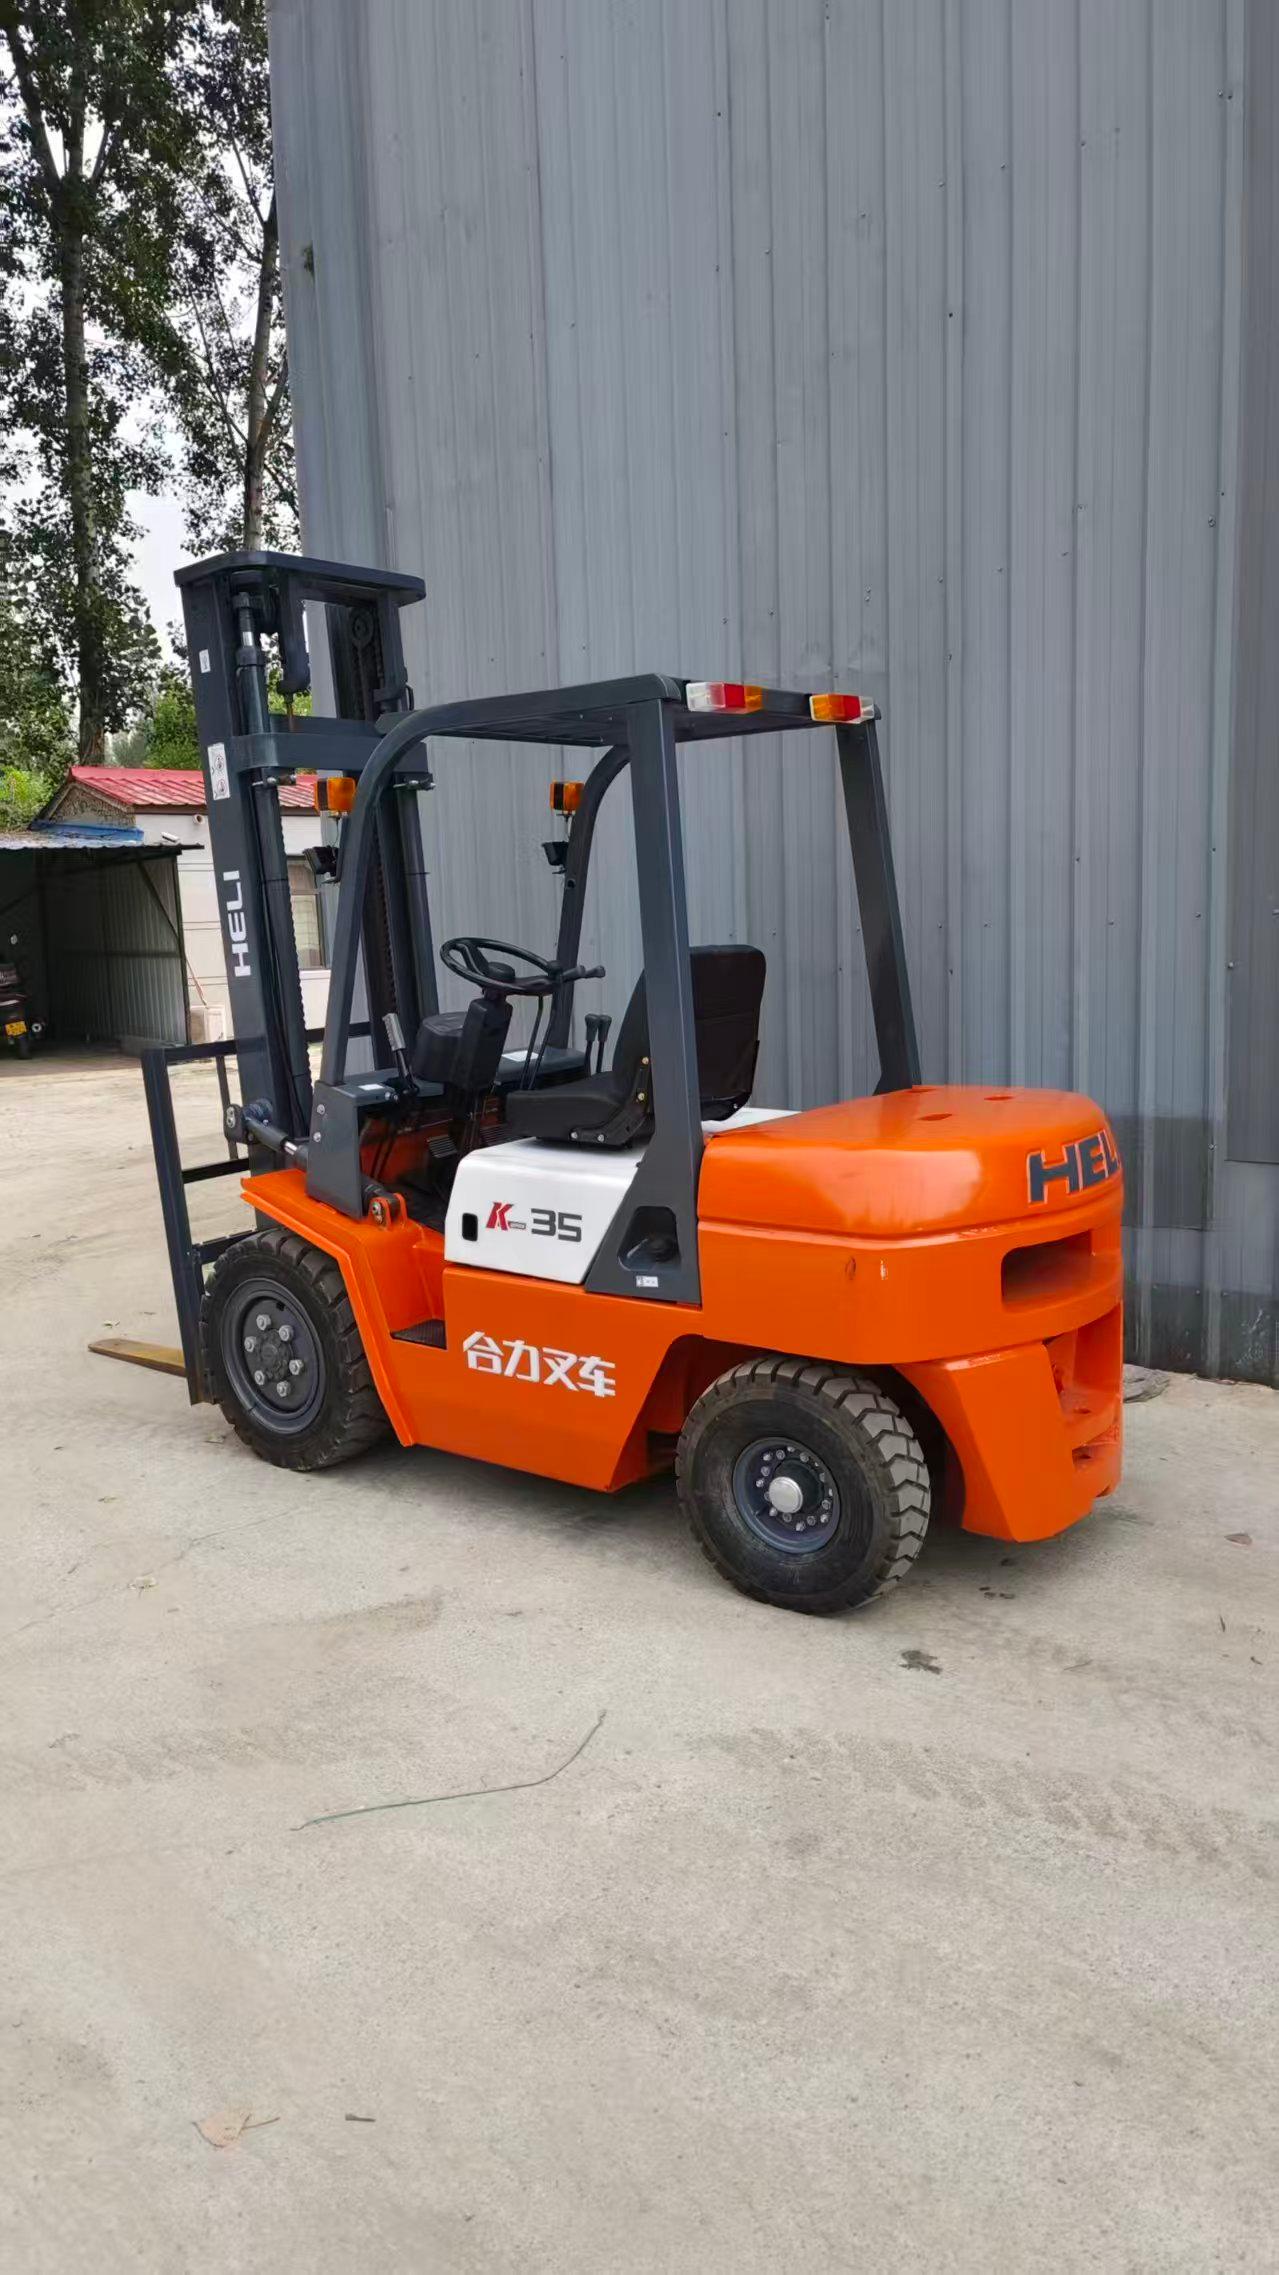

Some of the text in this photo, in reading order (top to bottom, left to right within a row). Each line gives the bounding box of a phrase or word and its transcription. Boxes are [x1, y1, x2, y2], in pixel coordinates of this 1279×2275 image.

[223, 870, 251, 977] HELI
[1027, 1129, 1121, 1204] HEL
[463, 1331, 616, 1397] 合力叉车
